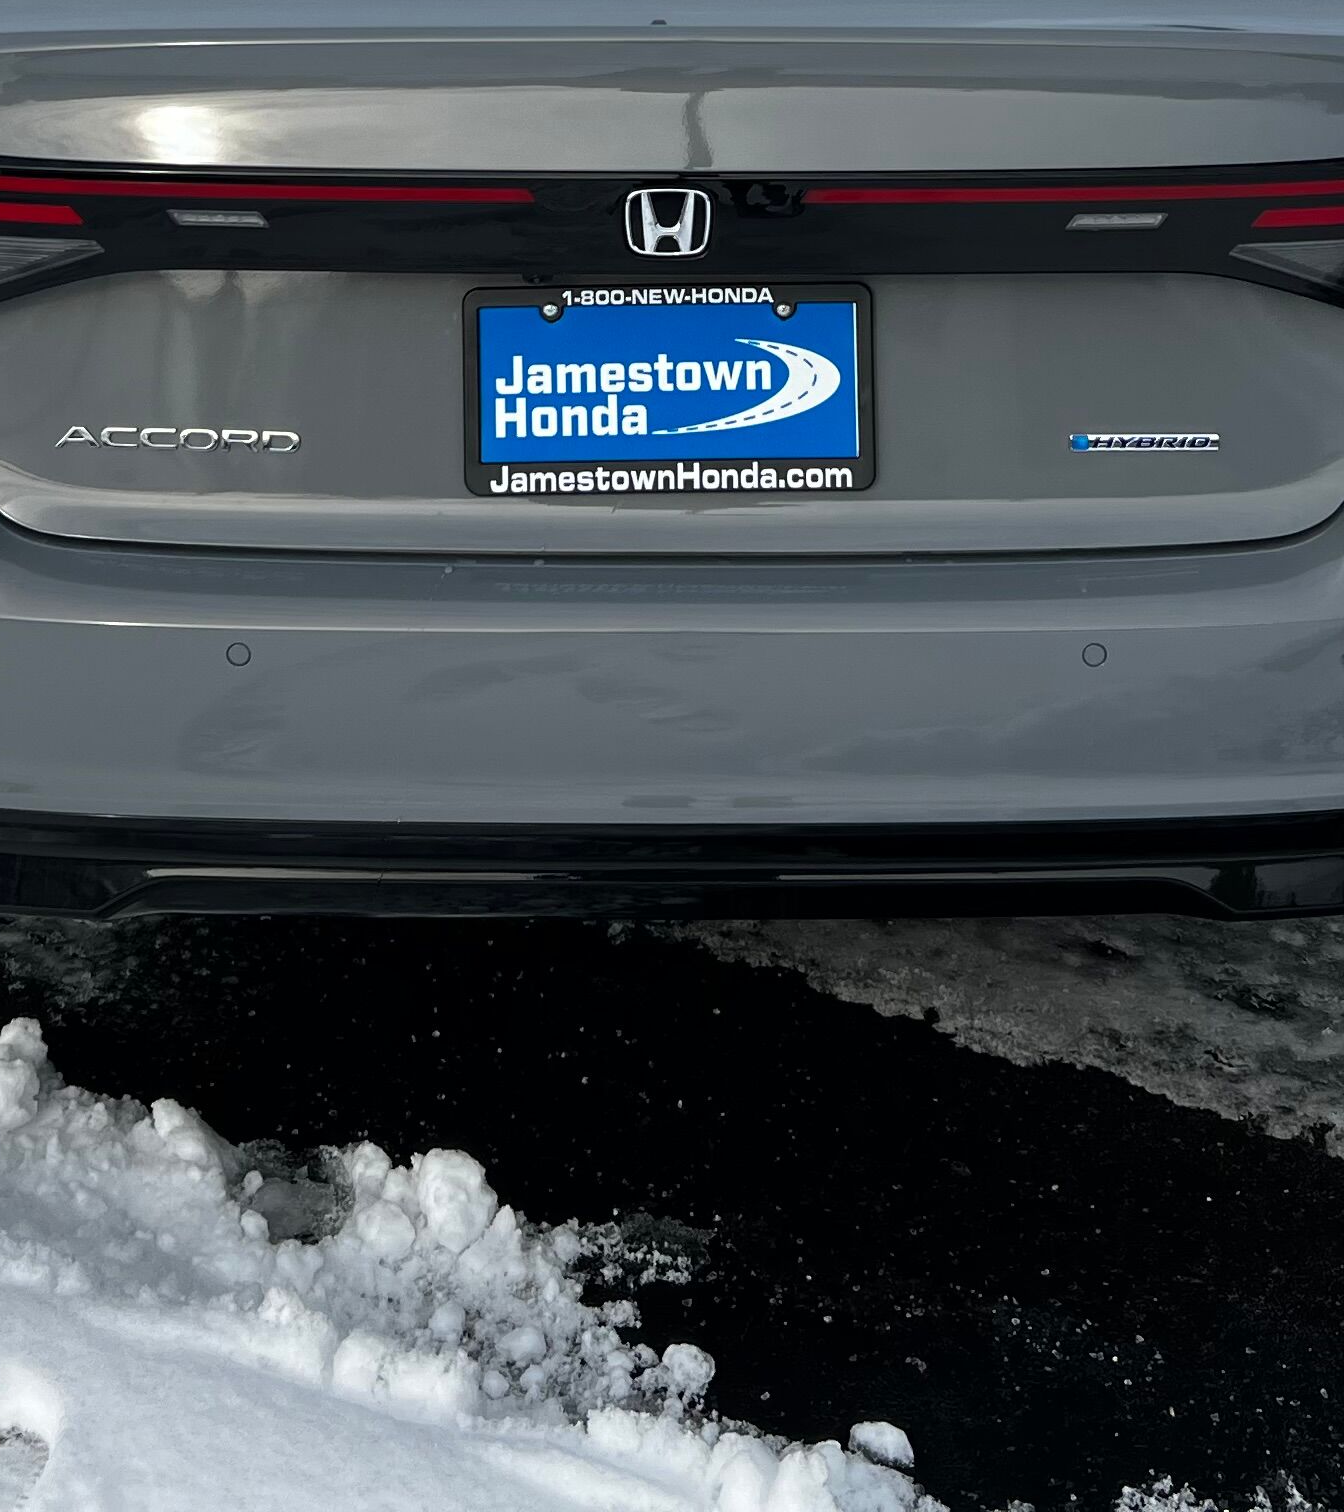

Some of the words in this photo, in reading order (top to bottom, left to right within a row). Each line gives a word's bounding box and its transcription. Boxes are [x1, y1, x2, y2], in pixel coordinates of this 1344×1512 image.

[562, 287, 774, 307] 1-800-NEW-HONDA
[495, 353, 772, 396] Jamestown
[495, 394, 649, 439] Honda
[54, 425, 302, 454] ACCORD
[1092, 436, 1212, 449] HYBRID
[490, 461, 854, 495] JamestownHonda.com
